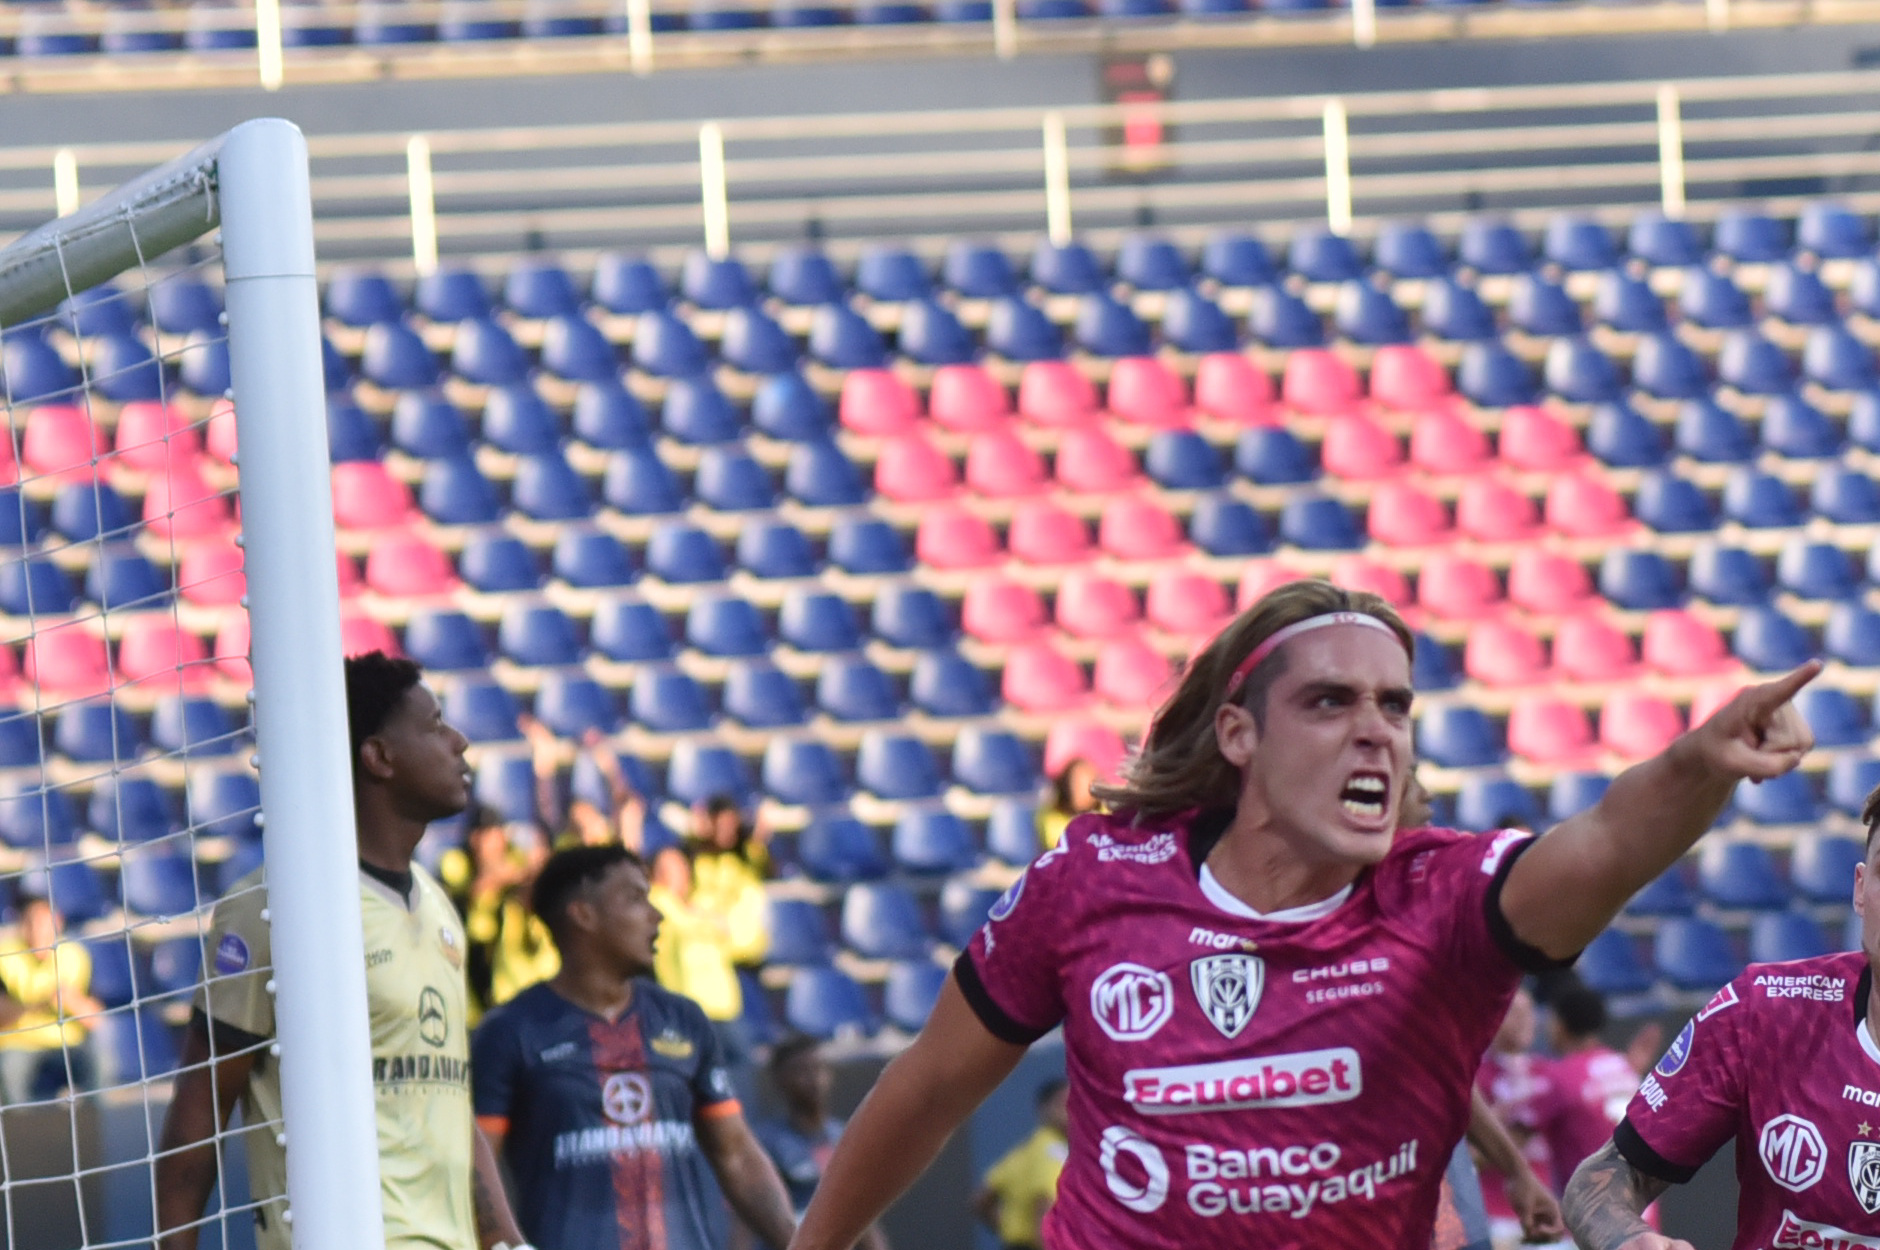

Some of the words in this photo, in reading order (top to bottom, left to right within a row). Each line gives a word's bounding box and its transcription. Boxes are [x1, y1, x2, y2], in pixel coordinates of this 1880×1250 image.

[1292, 957, 1390, 983] CHUBB
[1754, 975, 1846, 988] AMERICAN
[1098, 972, 1166, 1033] MG
[1305, 981, 1385, 1004] SEGUROS
[1766, 986, 1845, 1001] EXPRESS
[1131, 1058, 1351, 1105] Ecuabet
[1185, 1142, 1342, 1181] Banco
[1766, 1123, 1820, 1185] MG
[1187, 1139, 1419, 1219] Guayaquil
